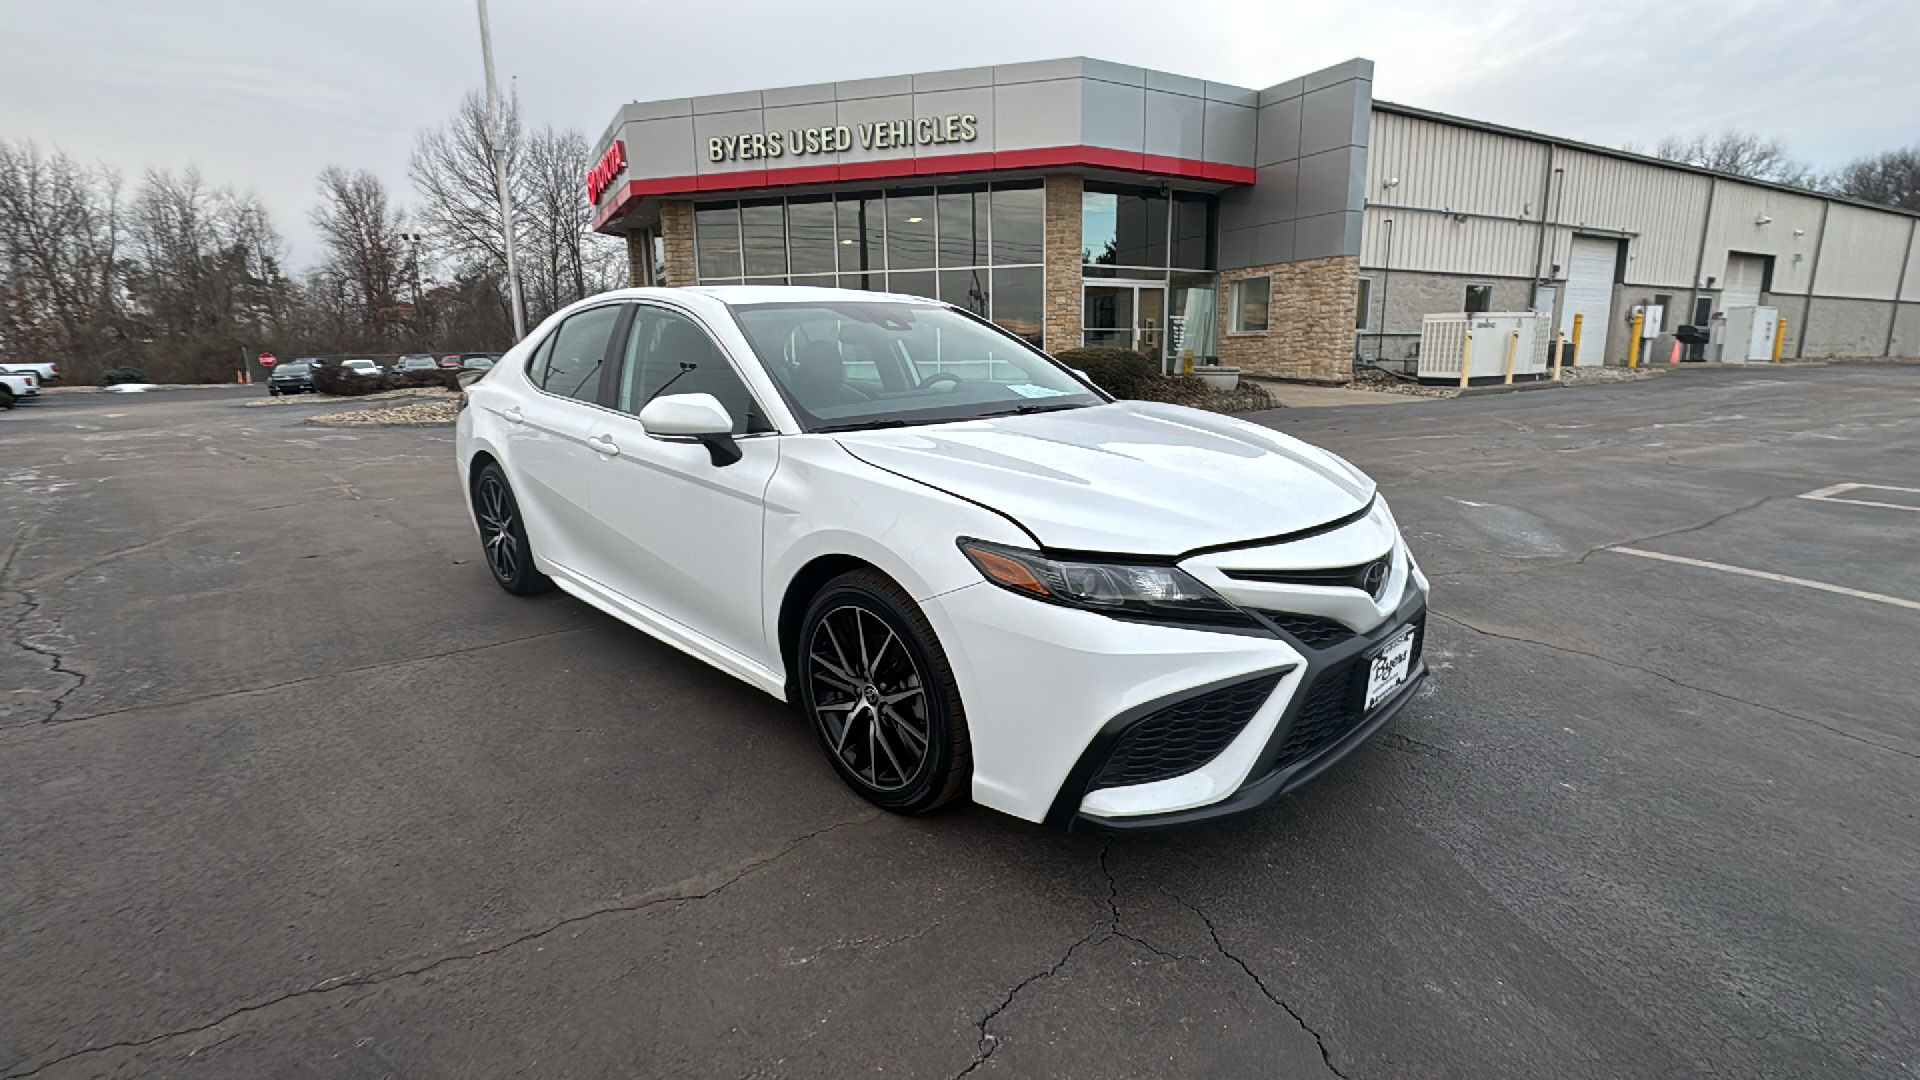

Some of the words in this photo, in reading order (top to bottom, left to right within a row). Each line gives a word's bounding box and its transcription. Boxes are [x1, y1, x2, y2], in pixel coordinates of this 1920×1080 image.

[708, 131, 782, 161] BYERS
[788, 125, 851, 155] USED
[858, 114, 977, 149] VEHICLES
